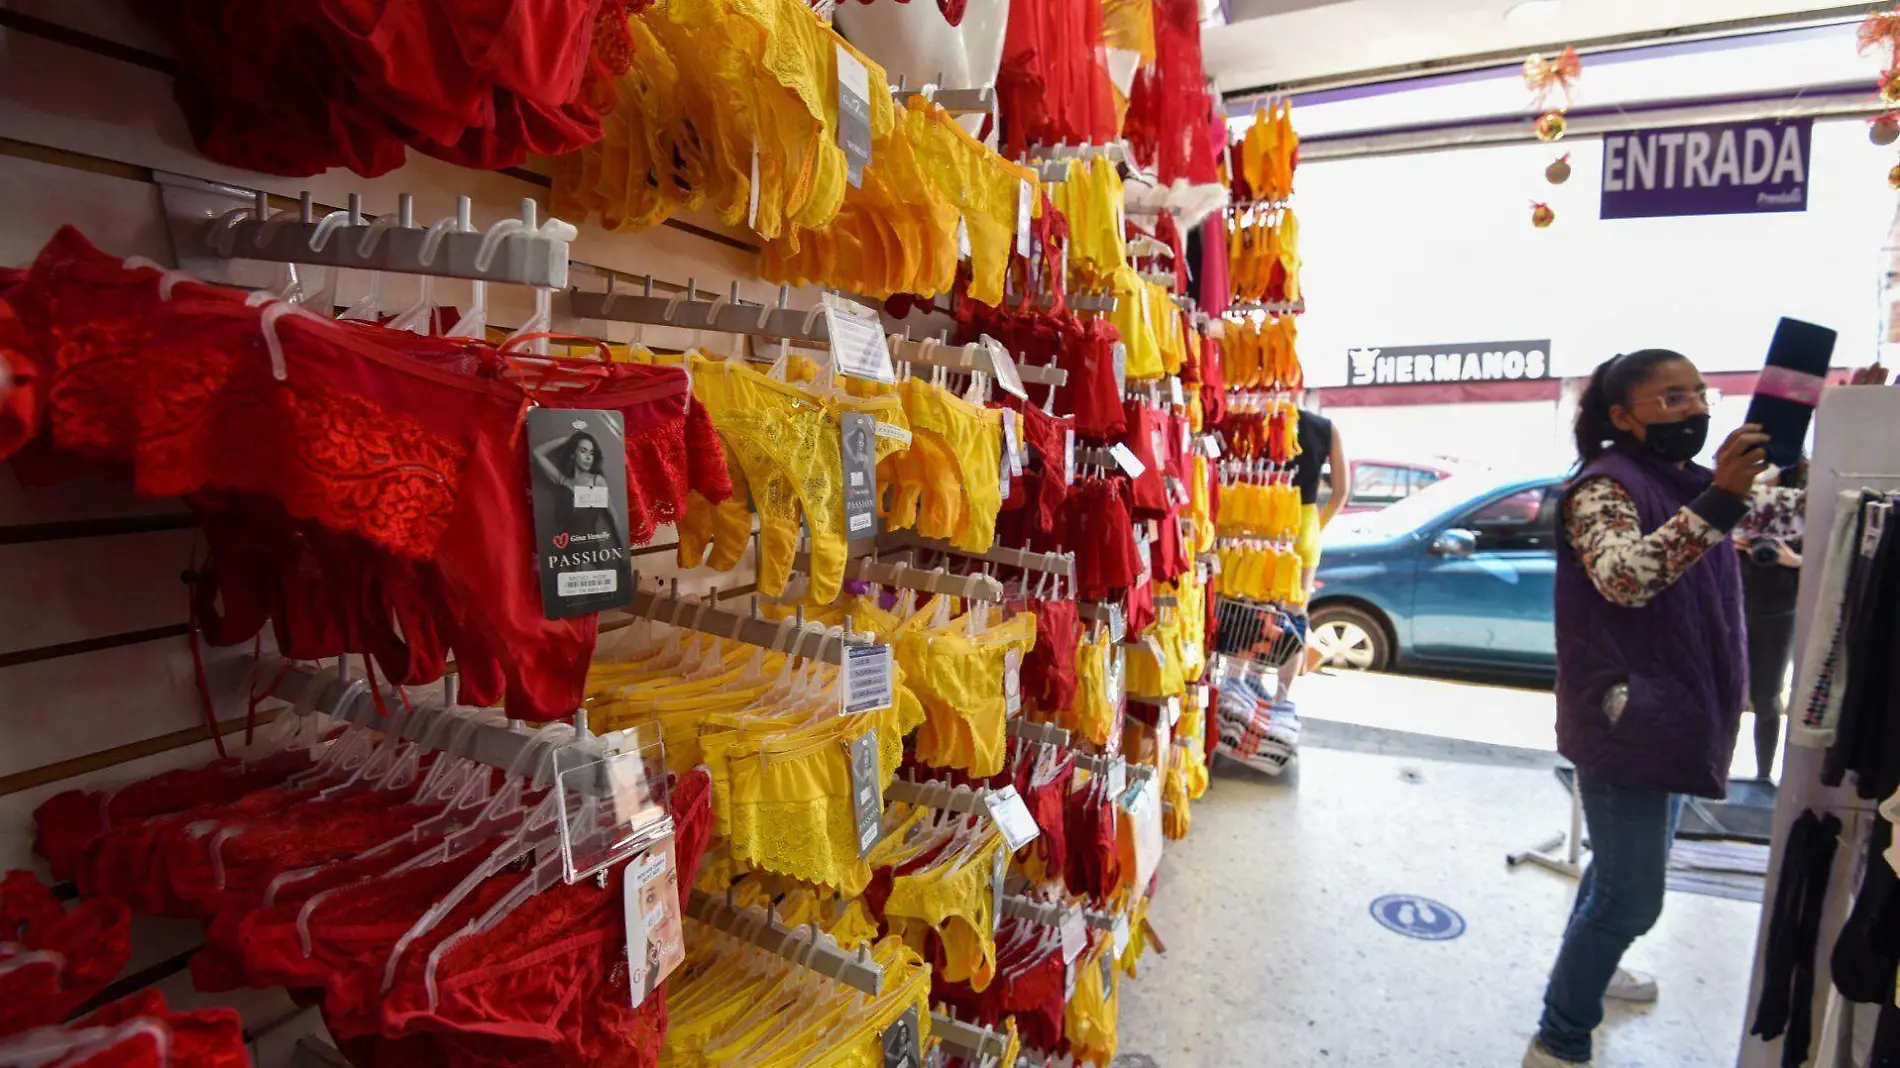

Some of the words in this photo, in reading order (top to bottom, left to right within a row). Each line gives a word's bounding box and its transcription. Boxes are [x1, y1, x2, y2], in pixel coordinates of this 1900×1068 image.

[1604, 126, 1804, 191] ENTRADA
[1376, 350, 1545, 383] HERMANOS
[548, 547, 622, 568] PASSION
